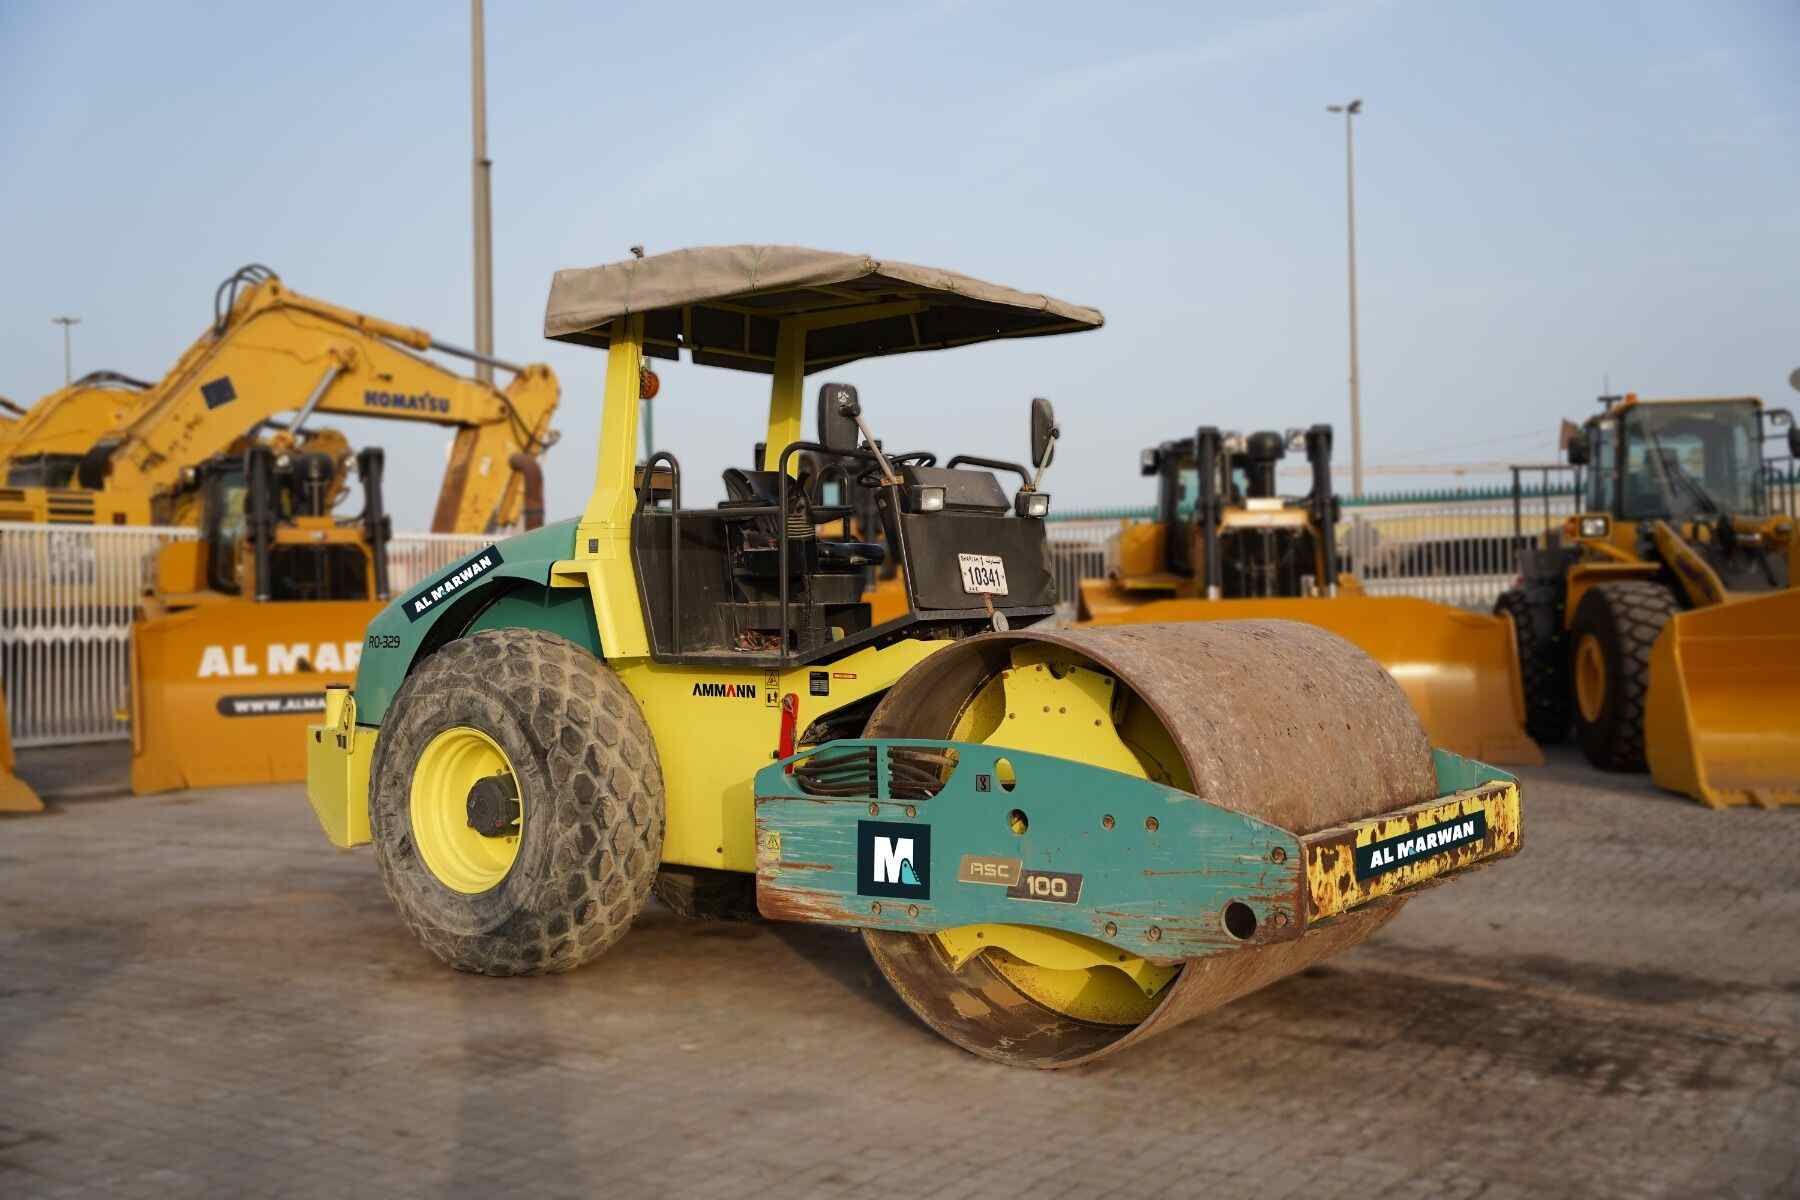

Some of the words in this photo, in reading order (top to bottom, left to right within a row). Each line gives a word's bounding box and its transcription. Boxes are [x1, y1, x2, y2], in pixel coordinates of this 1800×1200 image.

[364, 389, 450, 413] KOMATSU
[413, 595, 432, 613] AL
[431, 555, 492, 601] MARWAN
[968, 566, 1001, 587] 10341
[368, 635, 400, 649] RO-329
[198, 645, 258, 677] AL
[267, 641, 363, 675] MAR
[692, 682, 756, 699] AMMANN
[234, 697, 326, 713] WWW.ALMA
[1370, 847, 1395, 869] AL
[1397, 820, 1475, 860] MARWAN
[1027, 875, 1067, 898] 100
